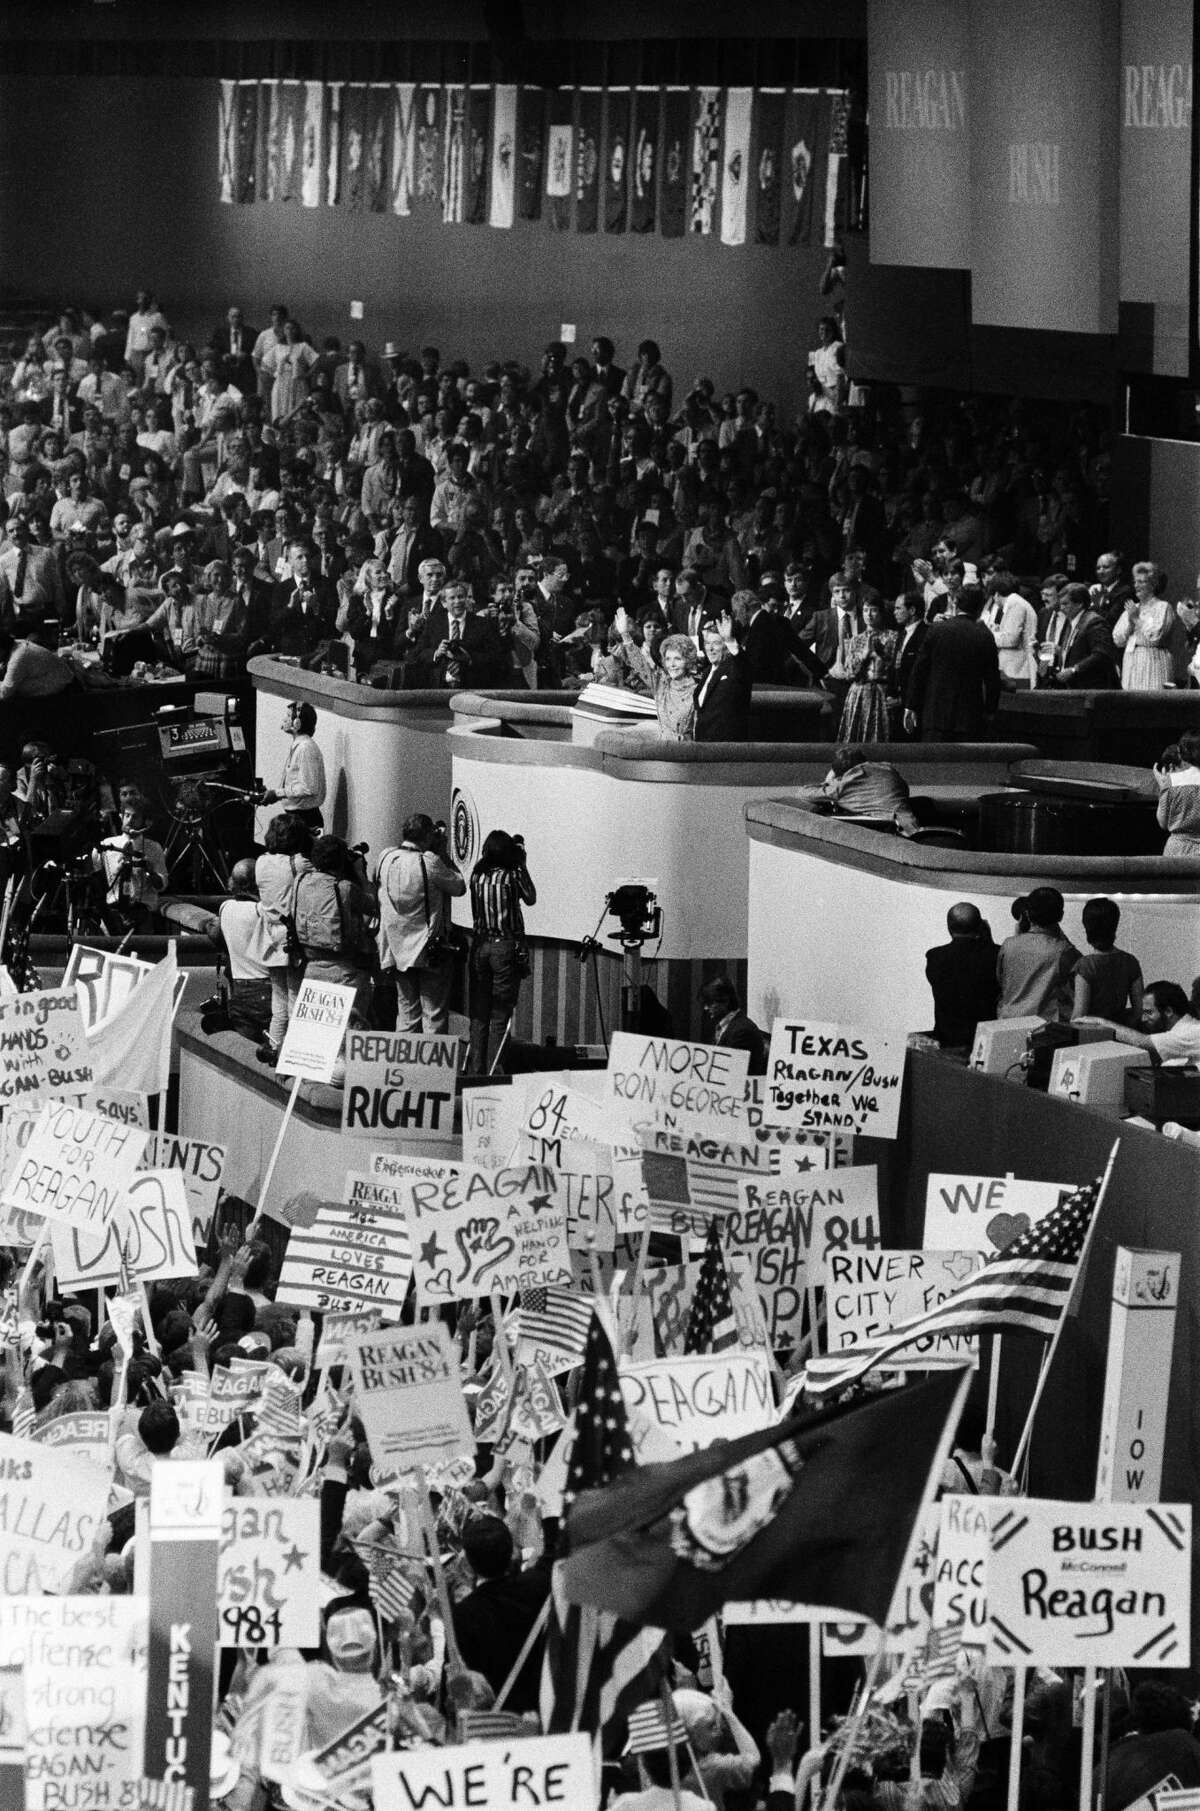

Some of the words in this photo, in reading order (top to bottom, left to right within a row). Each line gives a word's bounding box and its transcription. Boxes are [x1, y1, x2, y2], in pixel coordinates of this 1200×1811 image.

[886, 70, 966, 129] REAGAN
[36, 993, 77, 1025] good
[296, 1003, 325, 1022] BUSH
[302, 987, 347, 1009] REAGAN
[0, 1027, 48, 1051] HANDS
[350, 1035, 456, 1068] REPUBLICAN
[785, 1025, 868, 1060] TEXAS
[384, 1068, 404, 1086] IS
[639, 1041, 732, 1086] MORE
[347, 1086, 451, 1129] RIGHT
[613, 1072, 656, 1103] RON
[670, 1081, 742, 1118] GEORGE
[529, 1089, 568, 1136] 84
[44, 1105, 131, 1158] YOUTH
[58, 1144, 95, 1172] FOR
[655, 1131, 760, 1166] REAGAN
[12, 1159, 119, 1224] REAGAN
[352, 1181, 400, 1205] REAGA
[411, 1165, 557, 1218] REAGAN
[744, 1184, 845, 1209] REAGAN
[939, 1180, 1007, 1214] WE
[328, 1228, 387, 1247] AMERICA
[725, 1204, 814, 1250] REAGAN
[822, 1214, 883, 1263] 84
[330, 1248, 385, 1270] LOVES
[518, 1250, 549, 1267] FOR
[831, 1254, 925, 1285] RIVER
[311, 1266, 390, 1296] REAGAN
[491, 1266, 575, 1293] AMERICA
[316, 1293, 364, 1313] BUSH
[834, 1289, 898, 1321] CITY
[358, 1340, 442, 1366] REAGAN
[361, 1366, 417, 1391] BUSH
[1127, 1409, 1144, 1490] IOW
[0, 1492, 93, 1552] ALLAS
[217, 1508, 289, 1547] gan
[1052, 1525, 1143, 1552] BUSH
[62, 1601, 118, 1628] best
[1020, 1567, 1167, 1638] Reagan
[223, 1606, 283, 1646] 984
[27, 1753, 115, 1779] EAGAN-
[399, 1752, 570, 1810] WE'RE
[44, 1780, 110, 1807] BUSH
